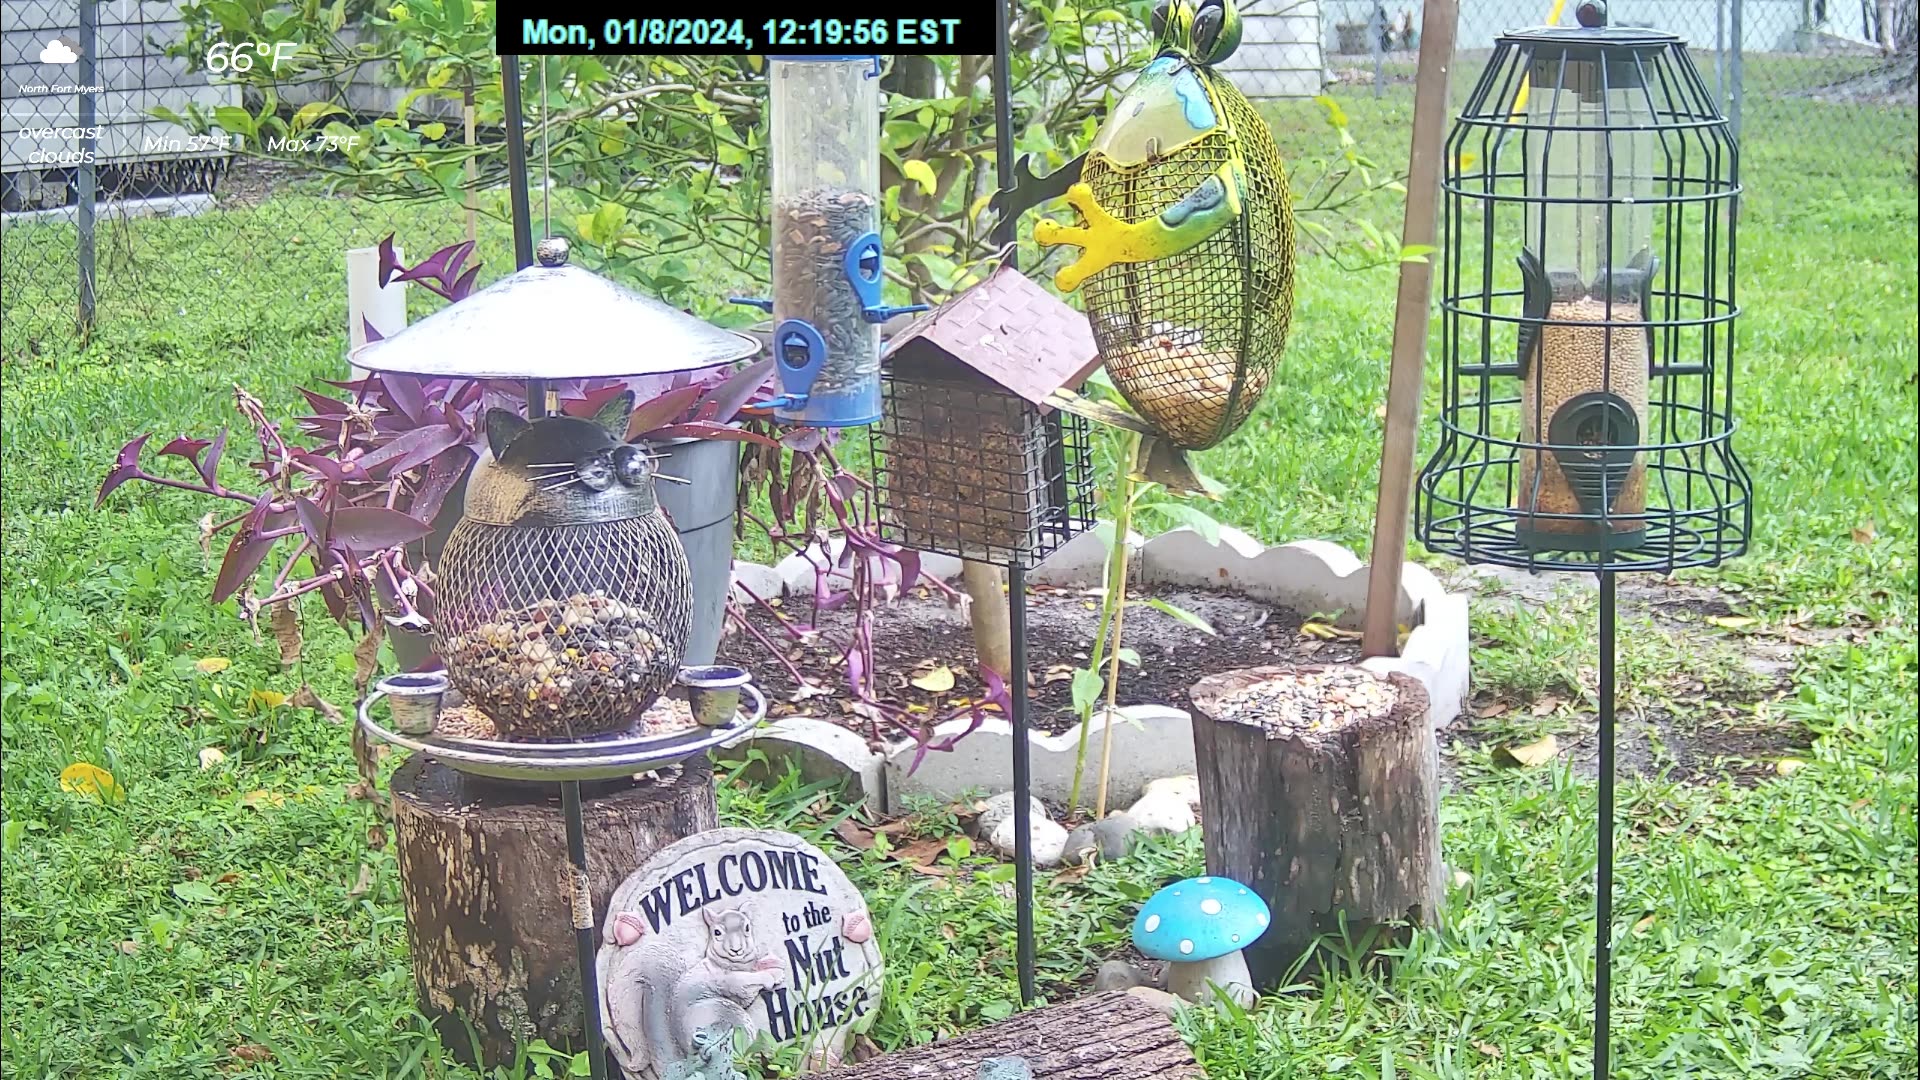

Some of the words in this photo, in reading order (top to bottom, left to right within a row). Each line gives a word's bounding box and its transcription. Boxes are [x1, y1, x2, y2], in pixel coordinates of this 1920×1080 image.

[638, 850, 828, 935] WELCOME
[782, 911, 800, 936] to
[803, 901, 832, 927] the
[784, 934, 851, 992] Nut
[760, 985, 871, 1043] House
